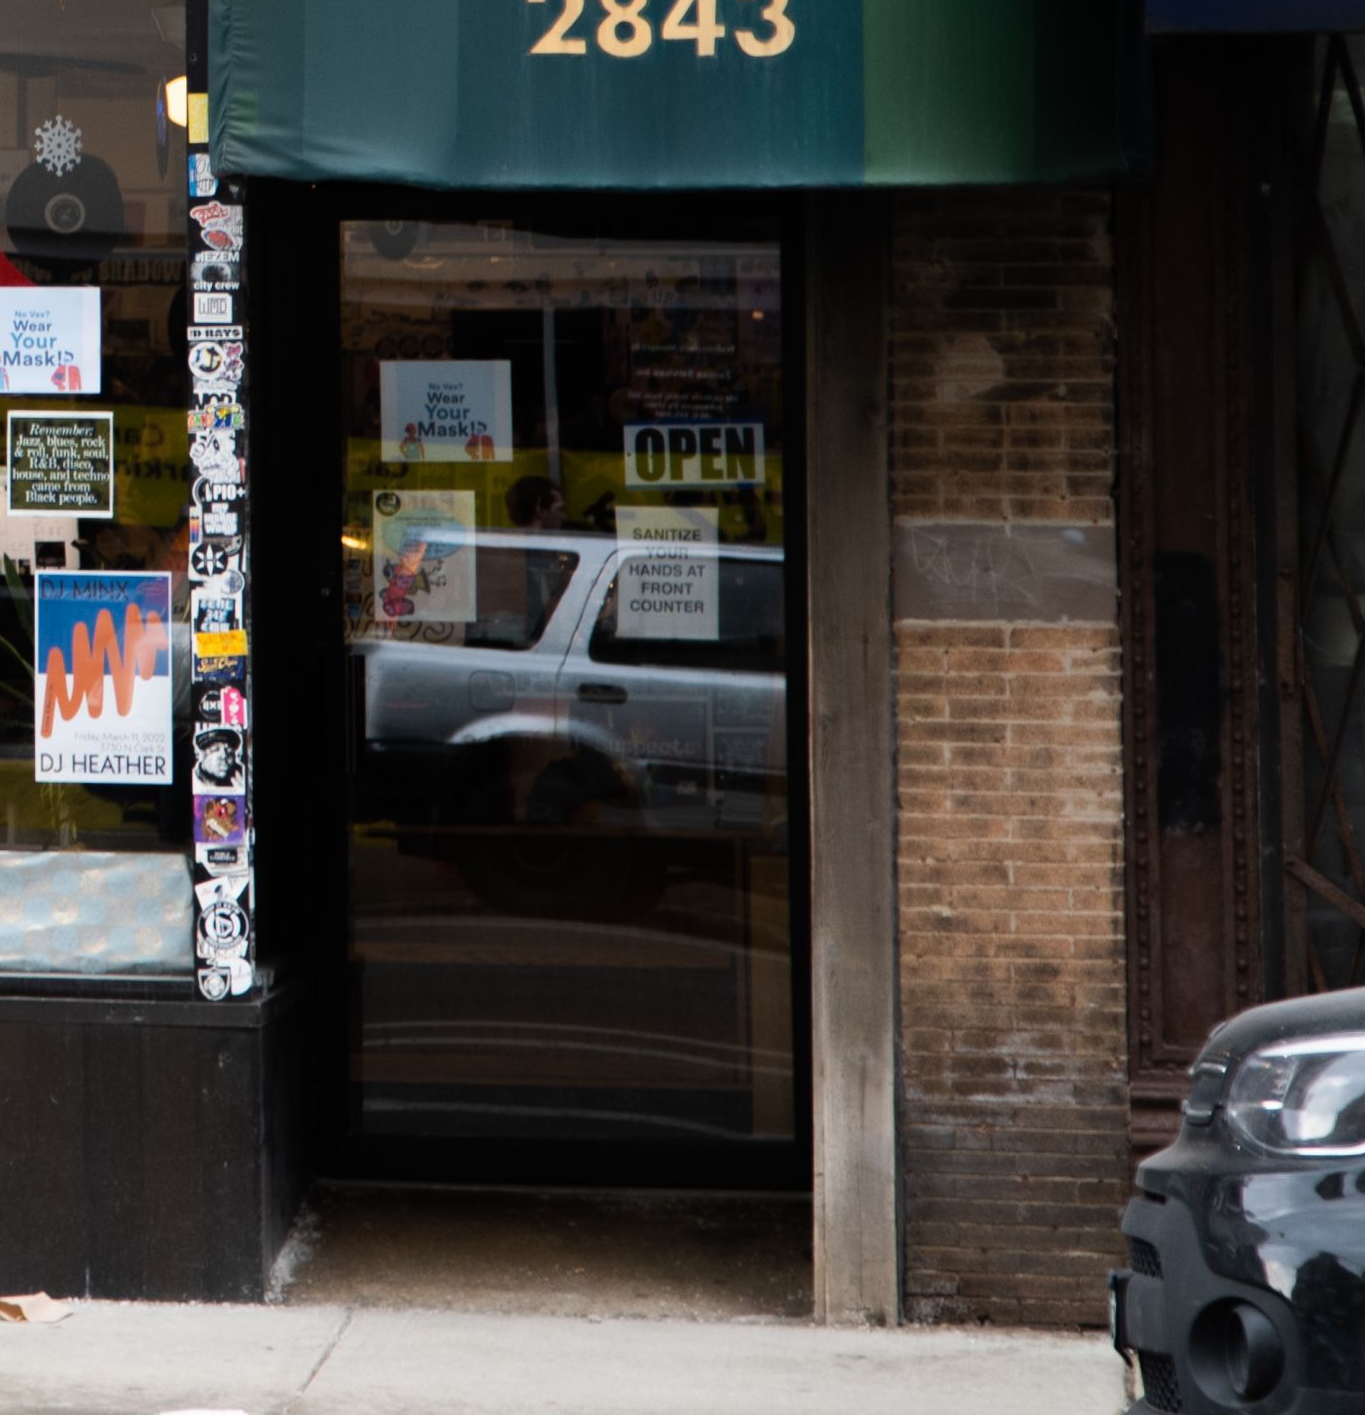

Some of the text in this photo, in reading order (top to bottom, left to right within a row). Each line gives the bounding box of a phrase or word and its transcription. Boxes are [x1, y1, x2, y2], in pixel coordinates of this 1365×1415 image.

[13, 320, 52, 332] Wear
[11, 332, 57, 349] Your
[427, 392, 466, 405] Wear
[425, 404, 470, 421] Your
[29, 424, 94, 436] Remember:
[16, 435, 106, 447] Jazz, blues, rock
[14, 447, 109, 459] & roll, funk, soul,
[635, 427, 756, 482] OPEN
[29, 458, 94, 470] R&B, disco,
[12, 469, 110, 481] house, and techno
[32, 481, 91, 492] came from
[25, 492, 98, 505] Black people.
[633, 528, 702, 542] SANITIZE
[647, 546, 689, 560] YOUR
[629, 564, 704, 578] HANDS AT
[41, 580, 129, 600] DJ MINX
[641, 582, 693, 596] FRONT
[630, 599, 704, 613] COUNTER
[40, 753, 166, 776] DJ HEATHER
